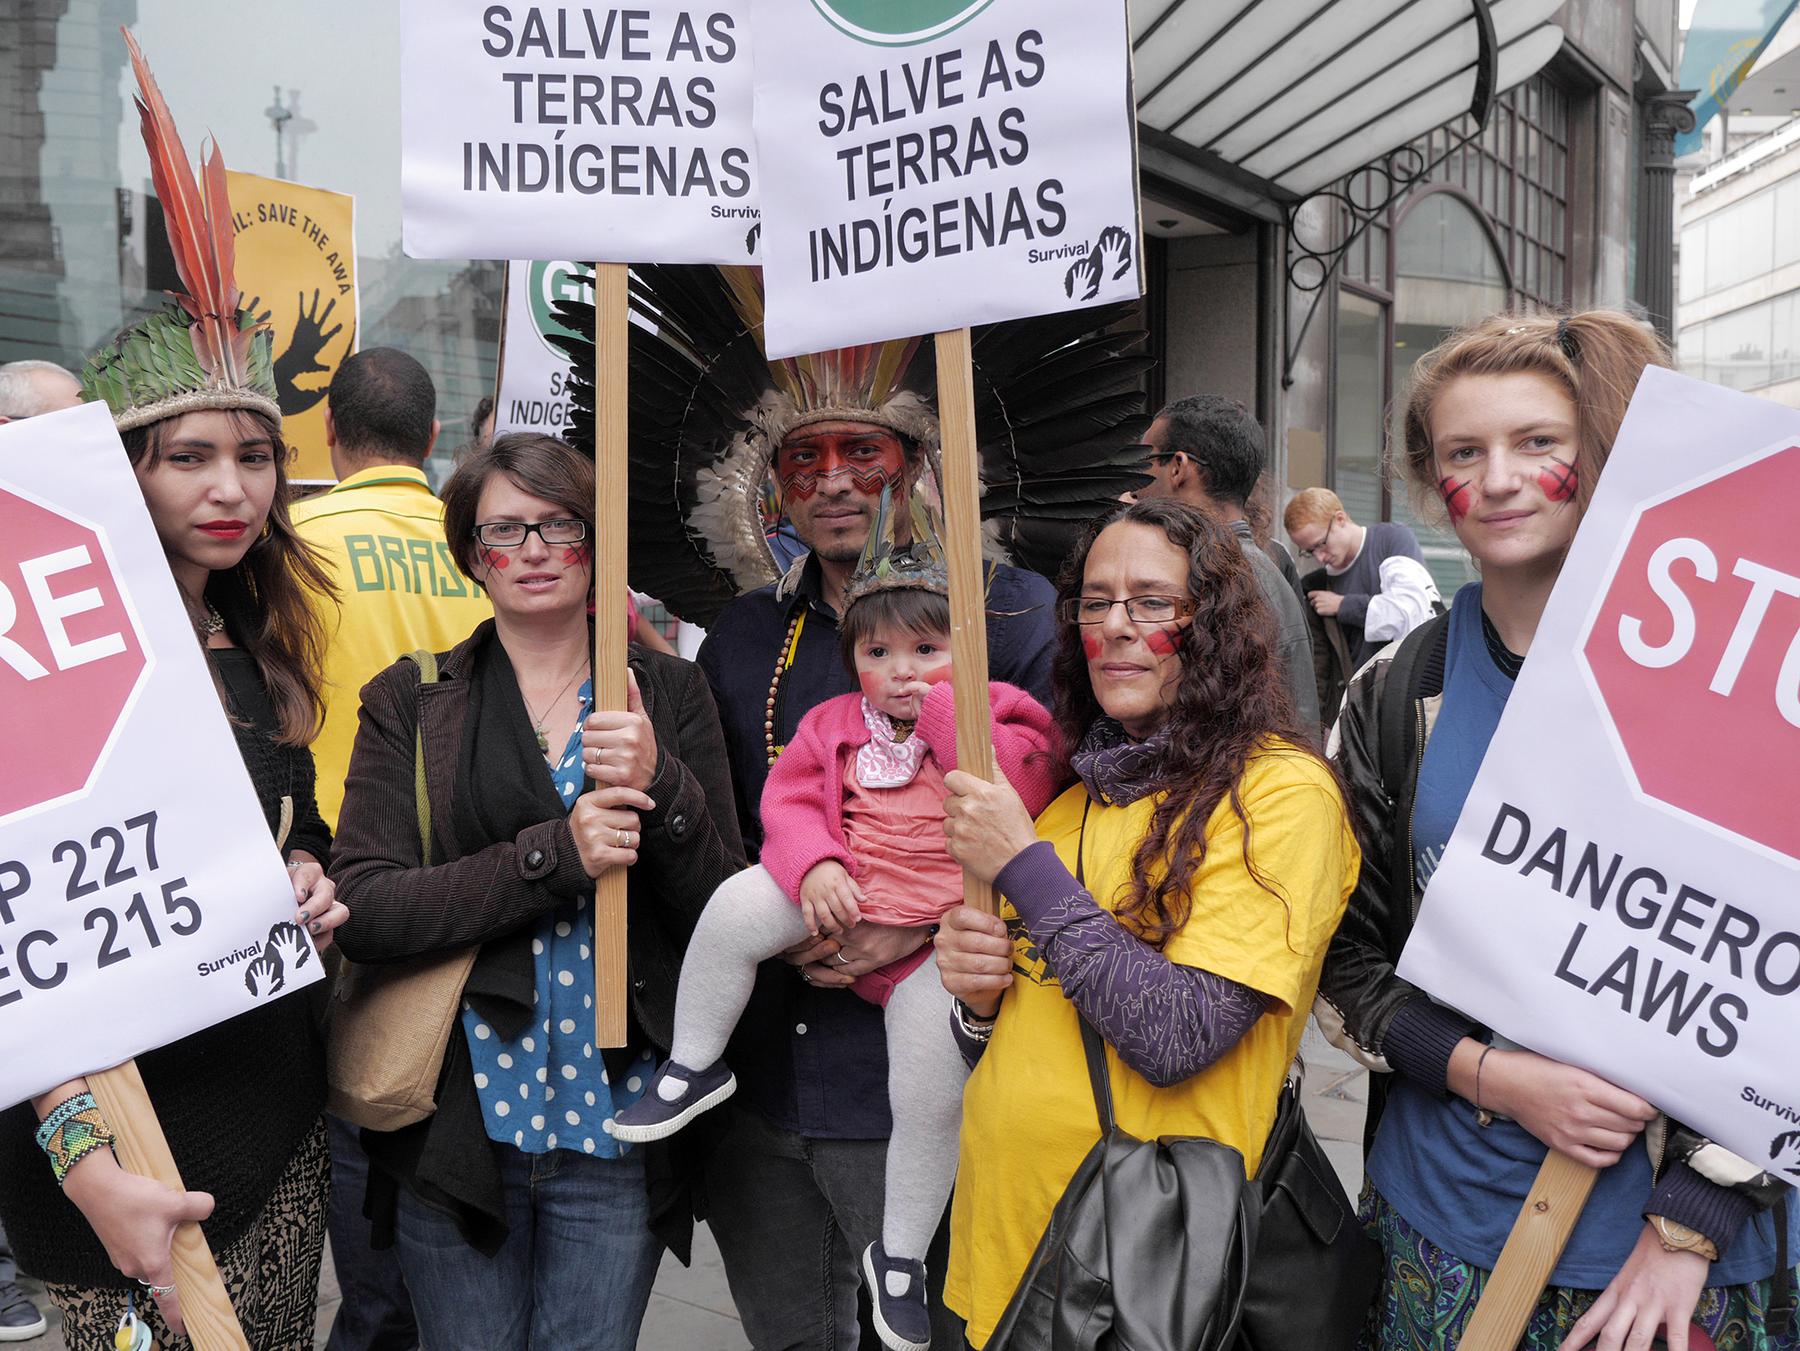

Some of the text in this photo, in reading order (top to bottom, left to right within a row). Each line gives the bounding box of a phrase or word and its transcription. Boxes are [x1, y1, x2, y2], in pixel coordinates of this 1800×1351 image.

[482, 5, 737, 63] SALVE AS
[502, 73, 717, 129] TERRAS
[818, 29, 1046, 137] SALVE AS
[463, 129, 751, 198] INDÍGENAS
[836, 107, 1029, 201] TERRAS
[232, 212, 254, 237] IL:
[257, 203, 298, 226] SAVE
[302, 215, 330, 251] THE
[710, 205, 761, 219] Surviv
[809, 178, 1067, 282] INDÍGENAS
[1028, 240, 1089, 263] Survival
[542, 261, 597, 315] G
[510, 400, 583, 426] INDIGE
[1618, 537, 1800, 729] ST
[52, 810, 159, 901] 227
[83, 876, 202, 969] 215
[1480, 802, 1800, 996] DANGERO
[197, 941, 262, 977] Survival
[1554, 922, 1748, 1058] LAWS
[1740, 1086, 1800, 1125] Surviv
